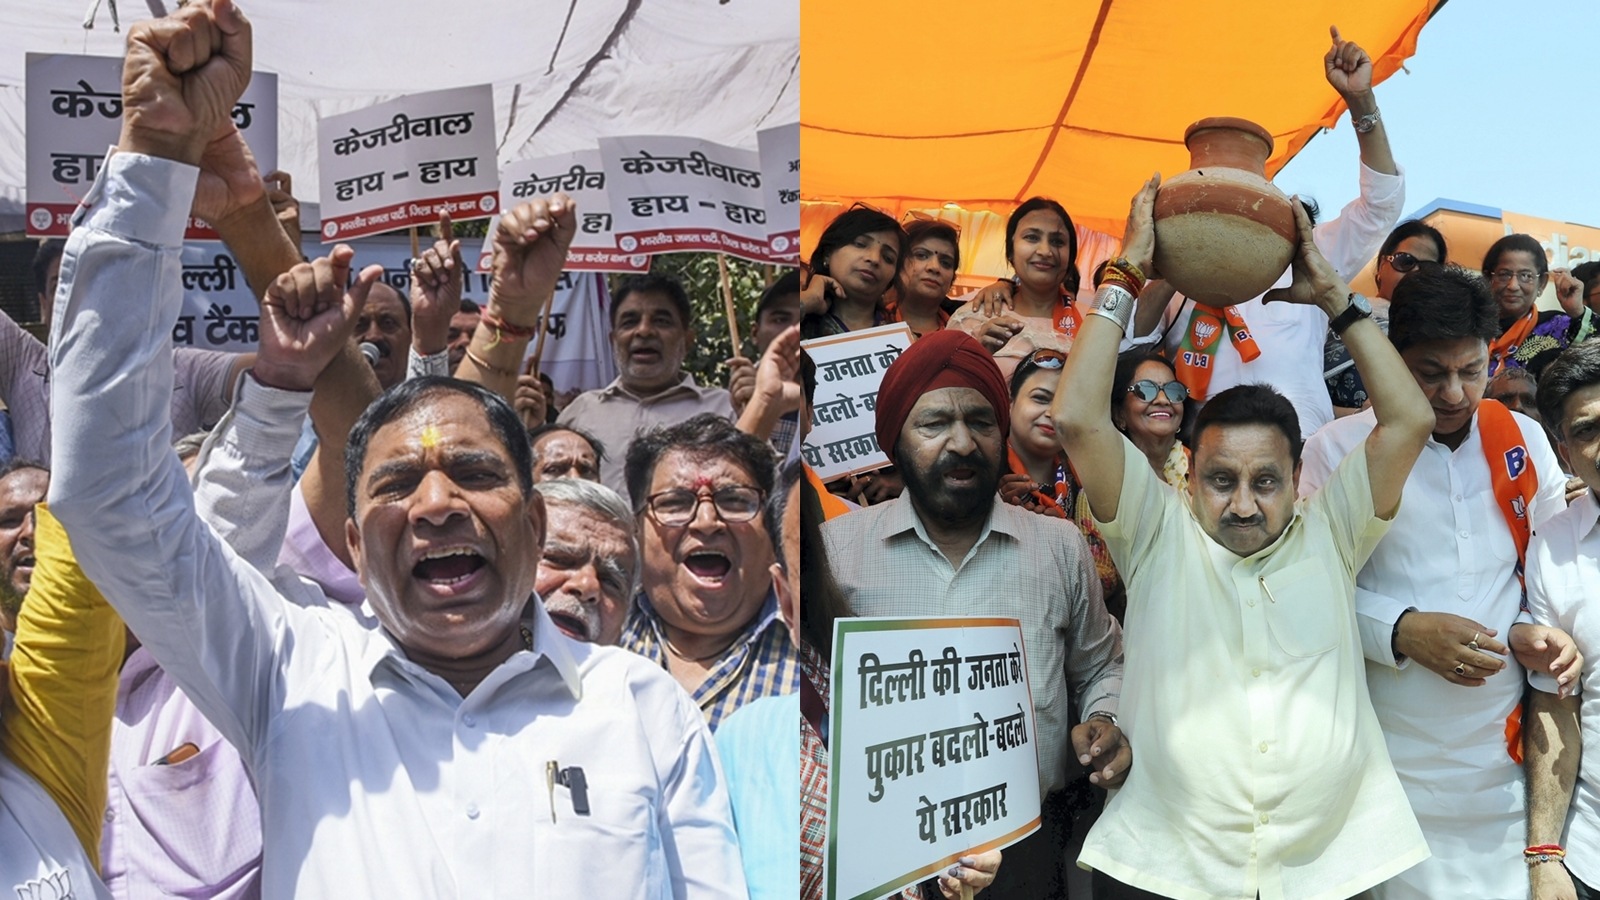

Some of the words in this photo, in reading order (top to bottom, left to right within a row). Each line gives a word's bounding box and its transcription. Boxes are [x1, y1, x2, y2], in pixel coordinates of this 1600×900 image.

[333, 113, 475, 156] केजरीवाल
[50, 153, 105, 184] हा
[334, 171, 385, 202] हाय
[393, 171, 409, 180] -
[418, 157, 478, 184] हाय
[512, 165, 605, 198] केजरीव
[620, 150, 762, 188] केजरीवाल
[581, 213, 612, 234] हा
[628, 195, 689, 217] हाय
[182, 254, 236, 292] ल्ली
[203, 302, 260, 345] टैंक
[817, 353, 877, 383] जनता
[823, 432, 882, 464] सरका
[858, 648, 928, 709] दिल्ली
[930, 647, 962, 696] की
[965, 652, 1009, 691] जनता
[1008, 642, 1023, 684] को
[865, 733, 927, 803] पुकार
[930, 703, 1028, 767] बदलो-बदलो
[916, 796, 938, 844] ये
[940, 782, 1008, 837] सरकार
